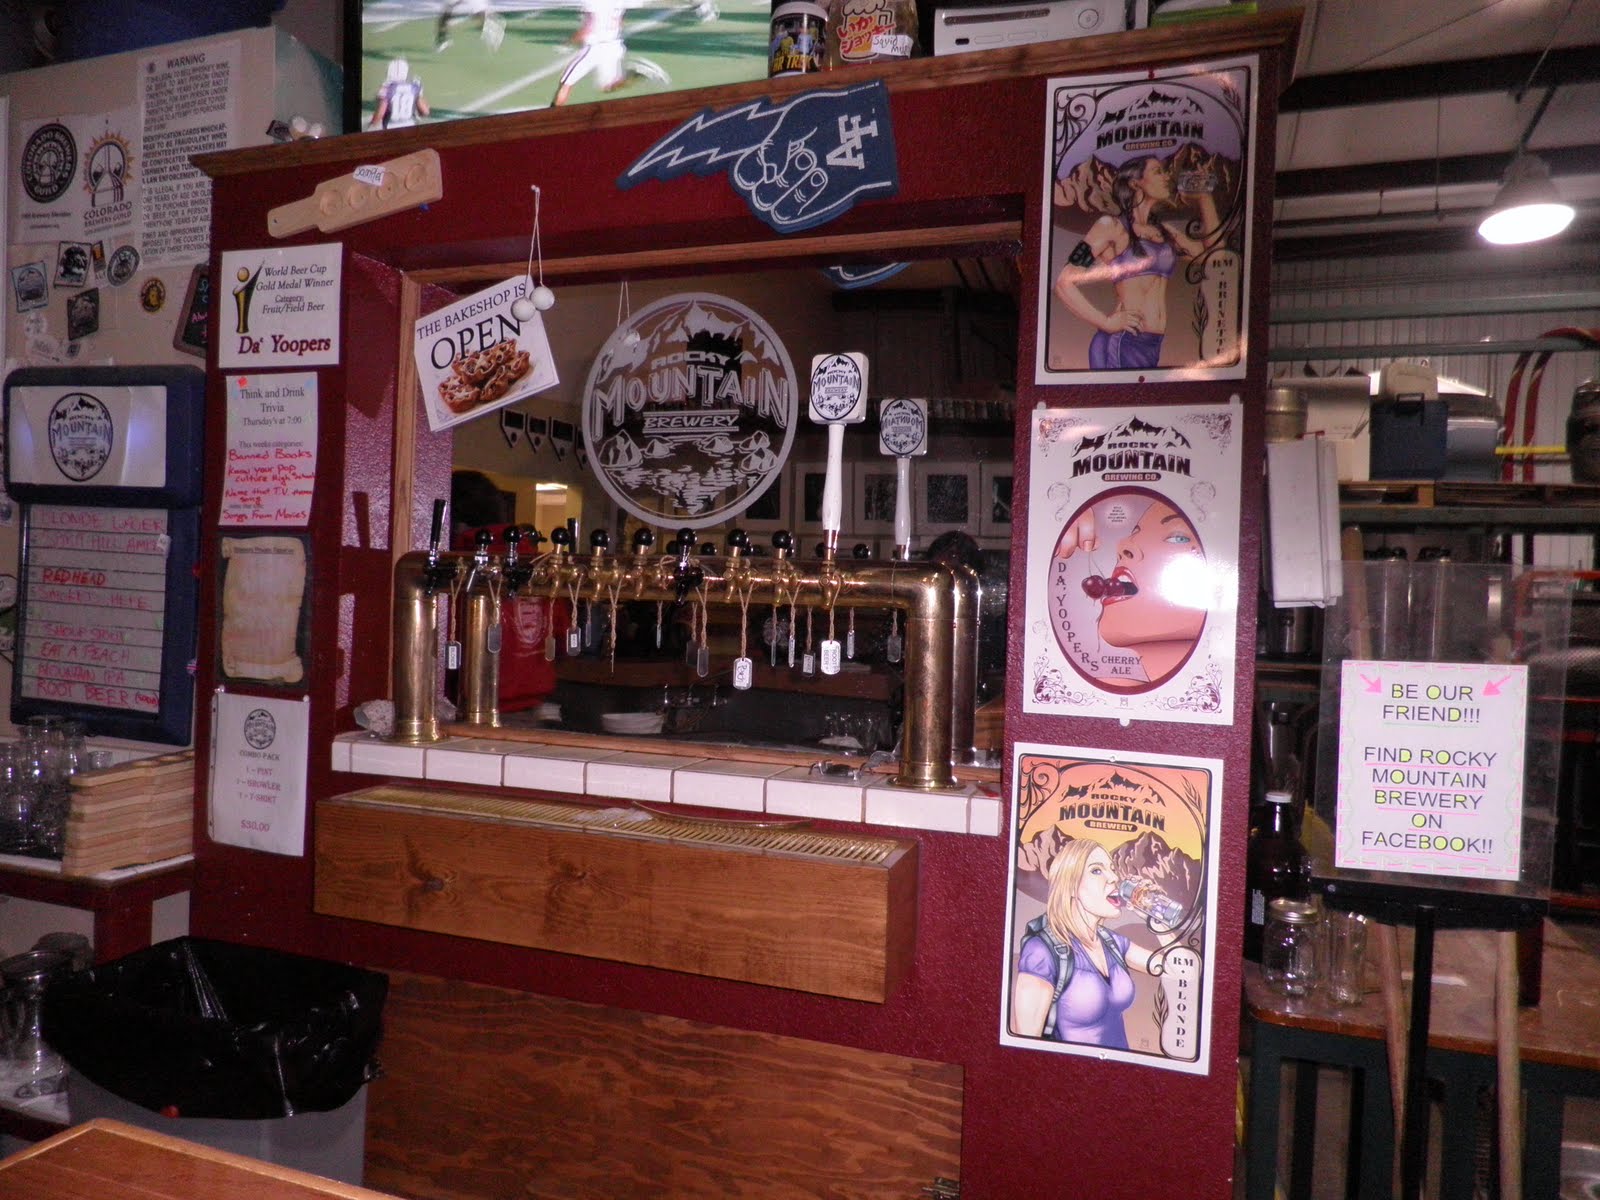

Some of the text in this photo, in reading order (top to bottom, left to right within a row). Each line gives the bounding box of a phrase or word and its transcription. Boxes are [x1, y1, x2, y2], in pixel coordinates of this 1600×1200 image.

[167, 53, 206, 68] WARNING
[1128, 111, 1175, 121] ROCKY
[1096, 120, 1204, 151] MOUNTAIN
[1125, 141, 1160, 151] BREWING
[83, 201, 133, 220] COLORADO
[264, 264, 327, 277] World Beer Cup
[256, 278, 334, 291] Gold Medal Winner
[275, 294, 304, 305] Category:
[262, 302, 325, 314] Fruit/Field Beer
[417, 283, 526, 340] THE BAKESHOP IS
[271, 334, 331, 356] Yoopers
[431, 313, 521, 370] OPEN
[652, 350, 731, 369] ROCKY
[240, 386, 305, 399] Think and Drink
[813, 374, 859, 396] MOUNTAIN
[260, 402, 284, 413] Trivia
[592, 365, 789, 443] MOUNTAIN
[287, 415, 302, 425] 7:00
[645, 415, 739, 429] BREWERY
[52, 420, 112, 449] MOUNTAIN
[1107, 441, 1159, 450] ROCKY
[275, 448, 312, 460] Books
[1070, 449, 1194, 480] MOUNTAIN
[1104, 473, 1159, 481] BREWING CO.
[1101, 655, 1143, 665] CHERRY
[1110, 666, 1131, 675] ALE
[85, 686, 130, 706] BEER
[1391, 683, 1473, 700] BE OUR
[1382, 705, 1481, 723] FRIEND!!!
[262, 753, 280, 761] PACK
[1364, 747, 1497, 767] FIND ROCKY
[1372, 768, 1486, 788] MOUNTAIN
[1091, 793, 1137, 803] ROCKY
[1375, 789, 1483, 810] BREWERY
[1059, 801, 1166, 832] MOUNTAIN
[1411, 813, 1442, 829] ON
[1089, 820, 1134, 832] BREWERY
[1362, 831, 1493, 854] FACEBOOK!!
[1173, 956, 1194, 967] RM
[1175, 978, 1188, 1048] BLONDE
